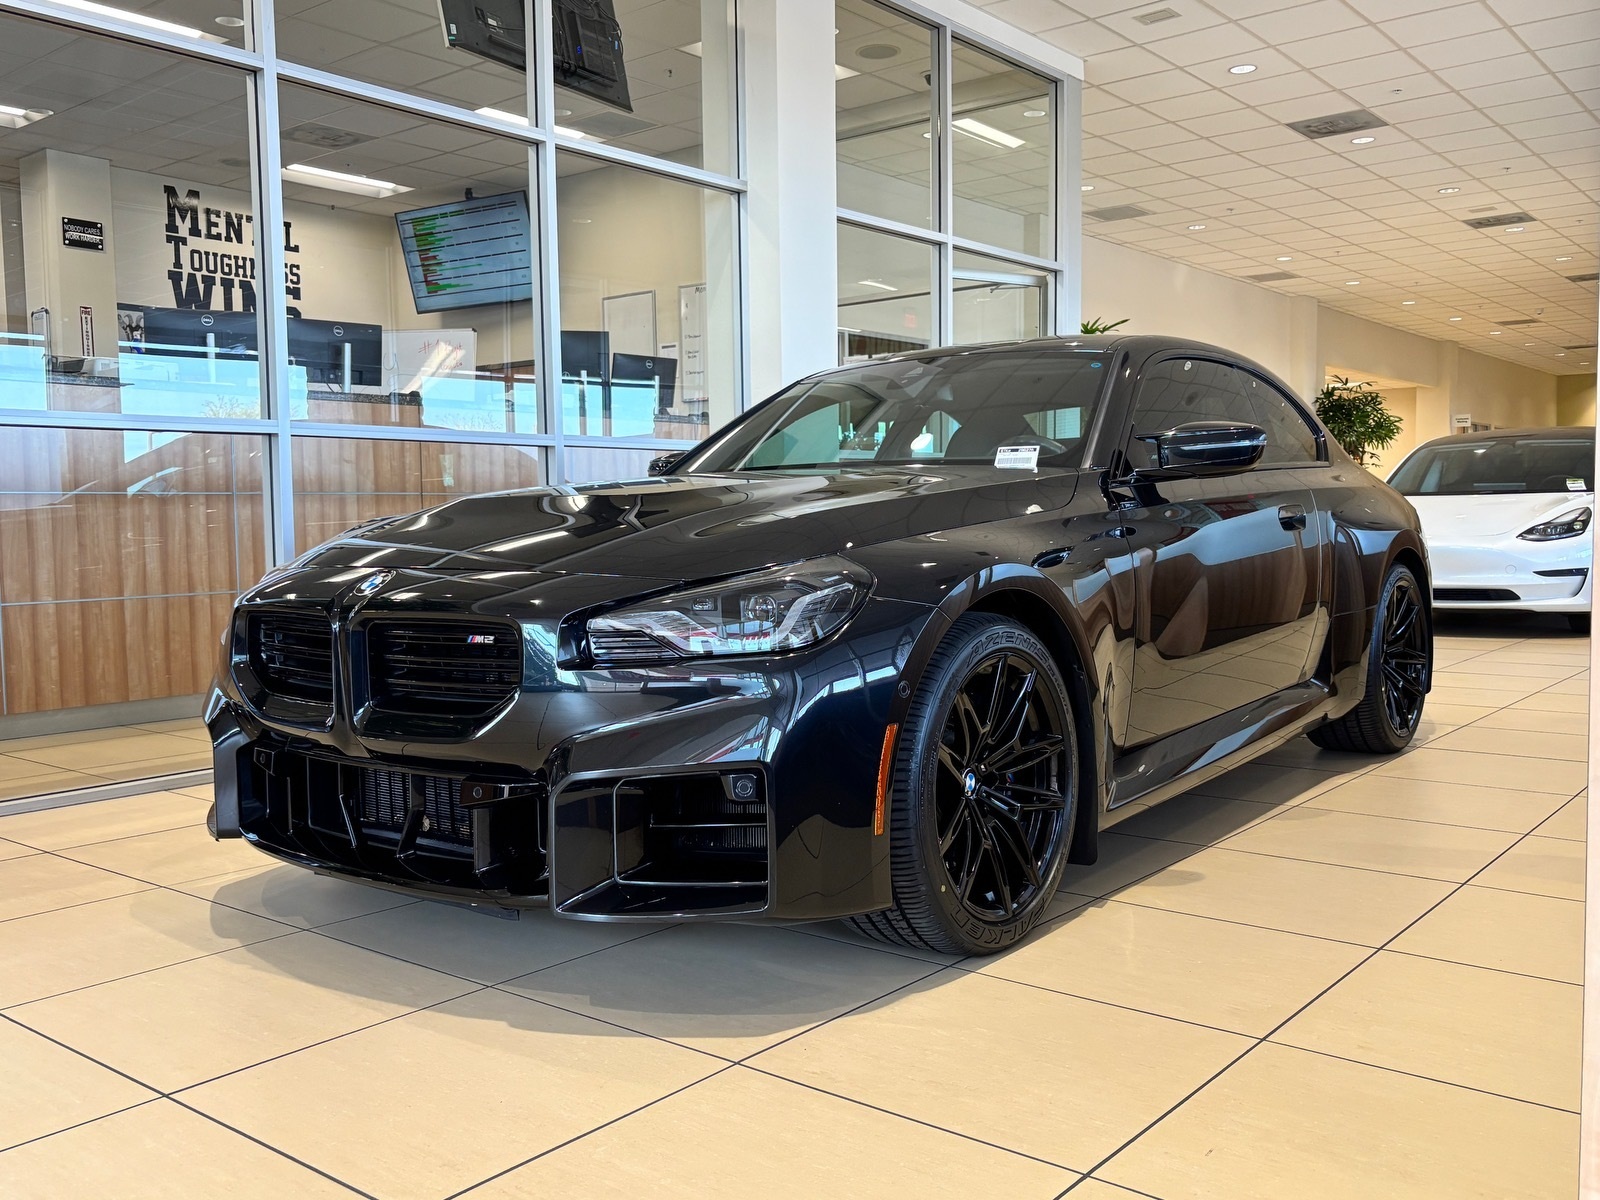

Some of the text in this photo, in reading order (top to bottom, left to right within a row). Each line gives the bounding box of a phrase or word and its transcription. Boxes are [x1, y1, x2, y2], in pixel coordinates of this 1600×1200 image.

[64, 224, 84, 233] NOBODY
[65, 232, 81, 241] WORK
[163, 185, 299, 253] MENL
[165, 234, 301, 286] TOUGHS
[475, 635, 495, 643] M2
[966, 631, 1050, 668] AZENIS
[951, 898, 1049, 944] FALKEN
